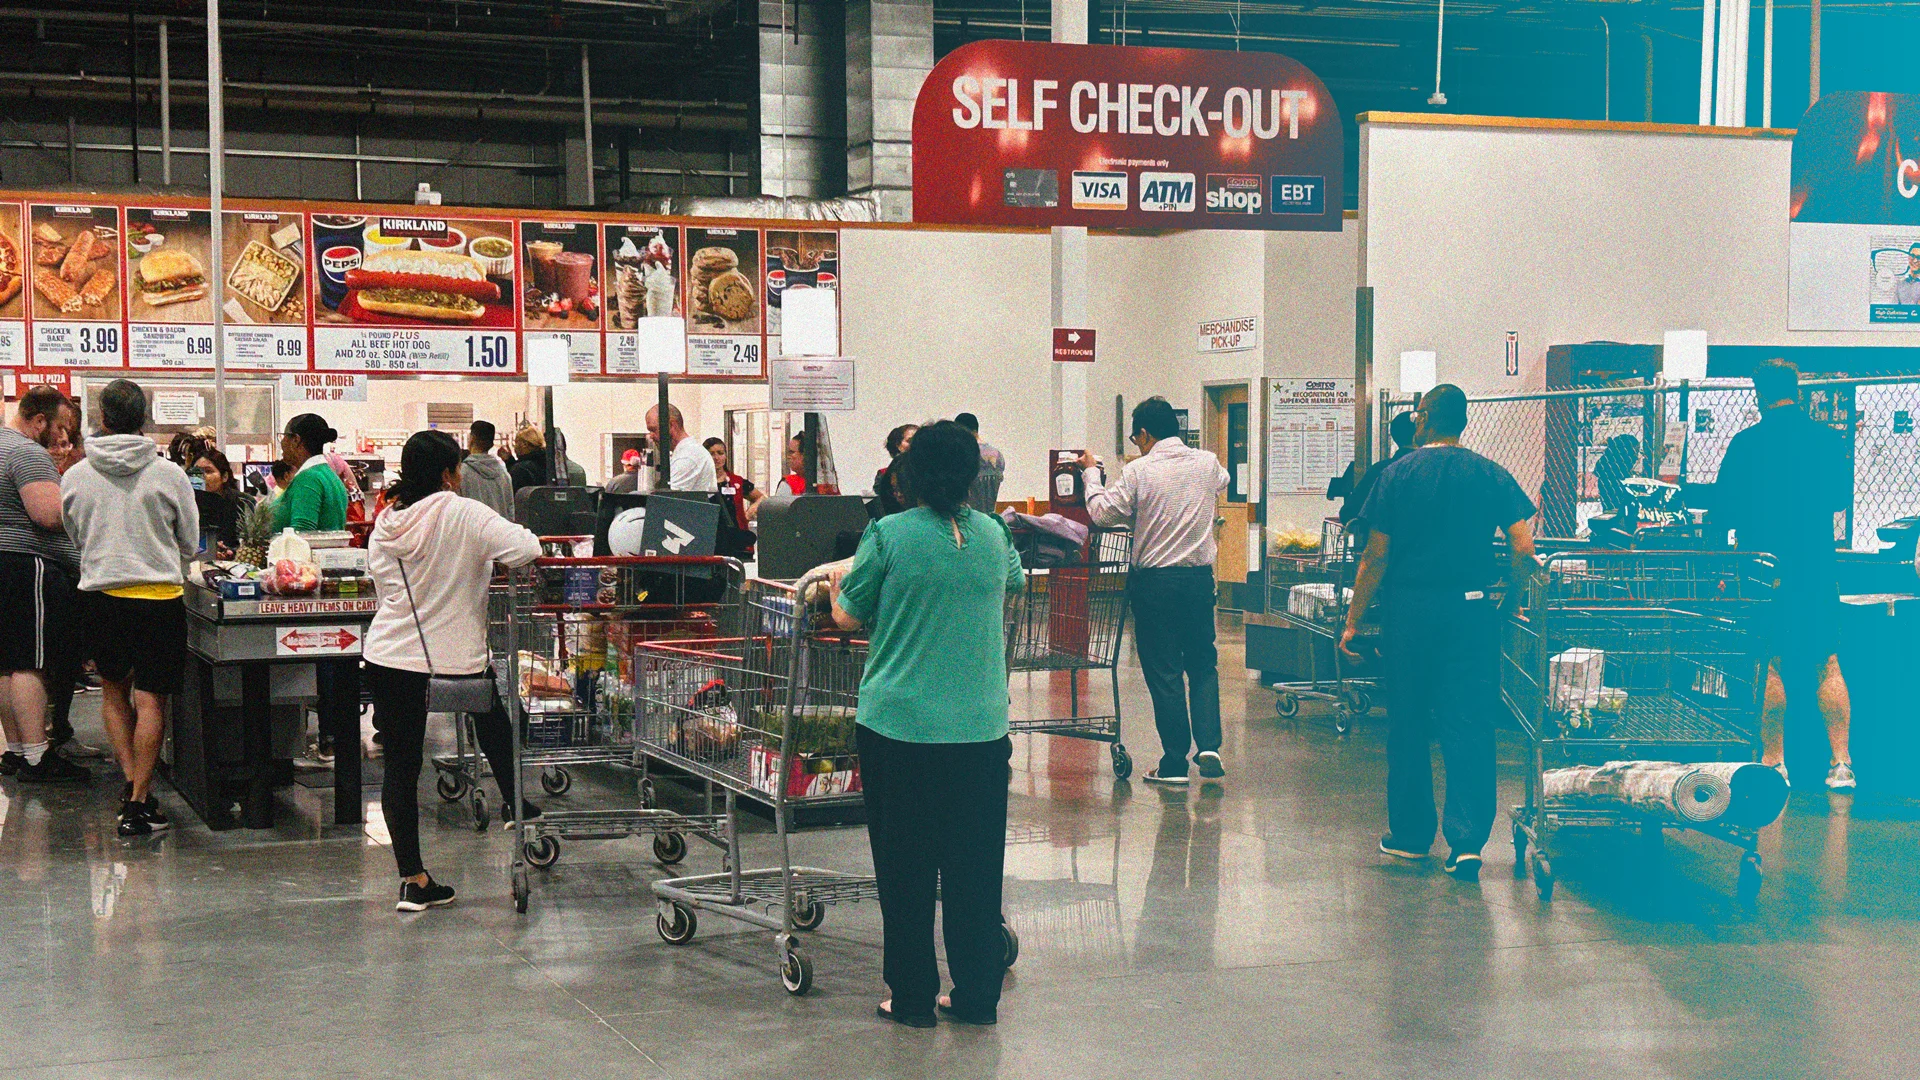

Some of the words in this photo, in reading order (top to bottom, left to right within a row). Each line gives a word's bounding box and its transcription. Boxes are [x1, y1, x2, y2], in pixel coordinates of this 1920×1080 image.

[952, 75, 1058, 130] SELF
[1069, 80, 1308, 140] CHECK-OUT
[1100, 158, 1126, 166] Electronic
[1128, 159, 1156, 167] payments
[1156, 160, 1170, 168] only
[1897, 158, 1919, 198] C
[1080, 182, 1121, 199] VISA
[1142, 180, 1194, 204] ATM
[1282, 184, 1315, 200] EBT
[1206, 187, 1262, 214] shop
[382, 218, 446, 232] KIRKLAND
[324, 258, 360, 268] PEPSI
[1200, 319, 1254, 336] MERCHANDISE
[80, 328, 118, 353] 3.99
[392, 332, 420, 340] PLUS
[620, 336, 635, 347] 2.49
[1211, 334, 1241, 348] PICK-UP
[187, 337, 212, 354] 6.99
[276, 339, 302, 356] 6.99
[351, 340, 367, 348] ALL
[370, 340, 390, 348] BEEF
[392, 340, 410, 349] HOT
[412, 341, 431, 350] DOG
[464, 335, 508, 368] 1.50
[335, 350, 354, 358] AND
[356, 350, 366, 358] 20
[383, 350, 407, 359] SODA
[733, 344, 758, 363] 2.49
[364, 360, 380, 368] 580
[388, 360, 404, 368] 850
[46, 374, 66, 384] PIZZA
[294, 374, 322, 386] KIOSK
[326, 375, 354, 387] ORDER
[306, 388, 344, 400] PICK-UP
[260, 602, 286, 614] LEAVE
[288, 602, 314, 612] HEAVY
[316, 602, 340, 612] ITEMS
[342, 601, 354, 611] ON
[356, 600, 378, 610] CART
